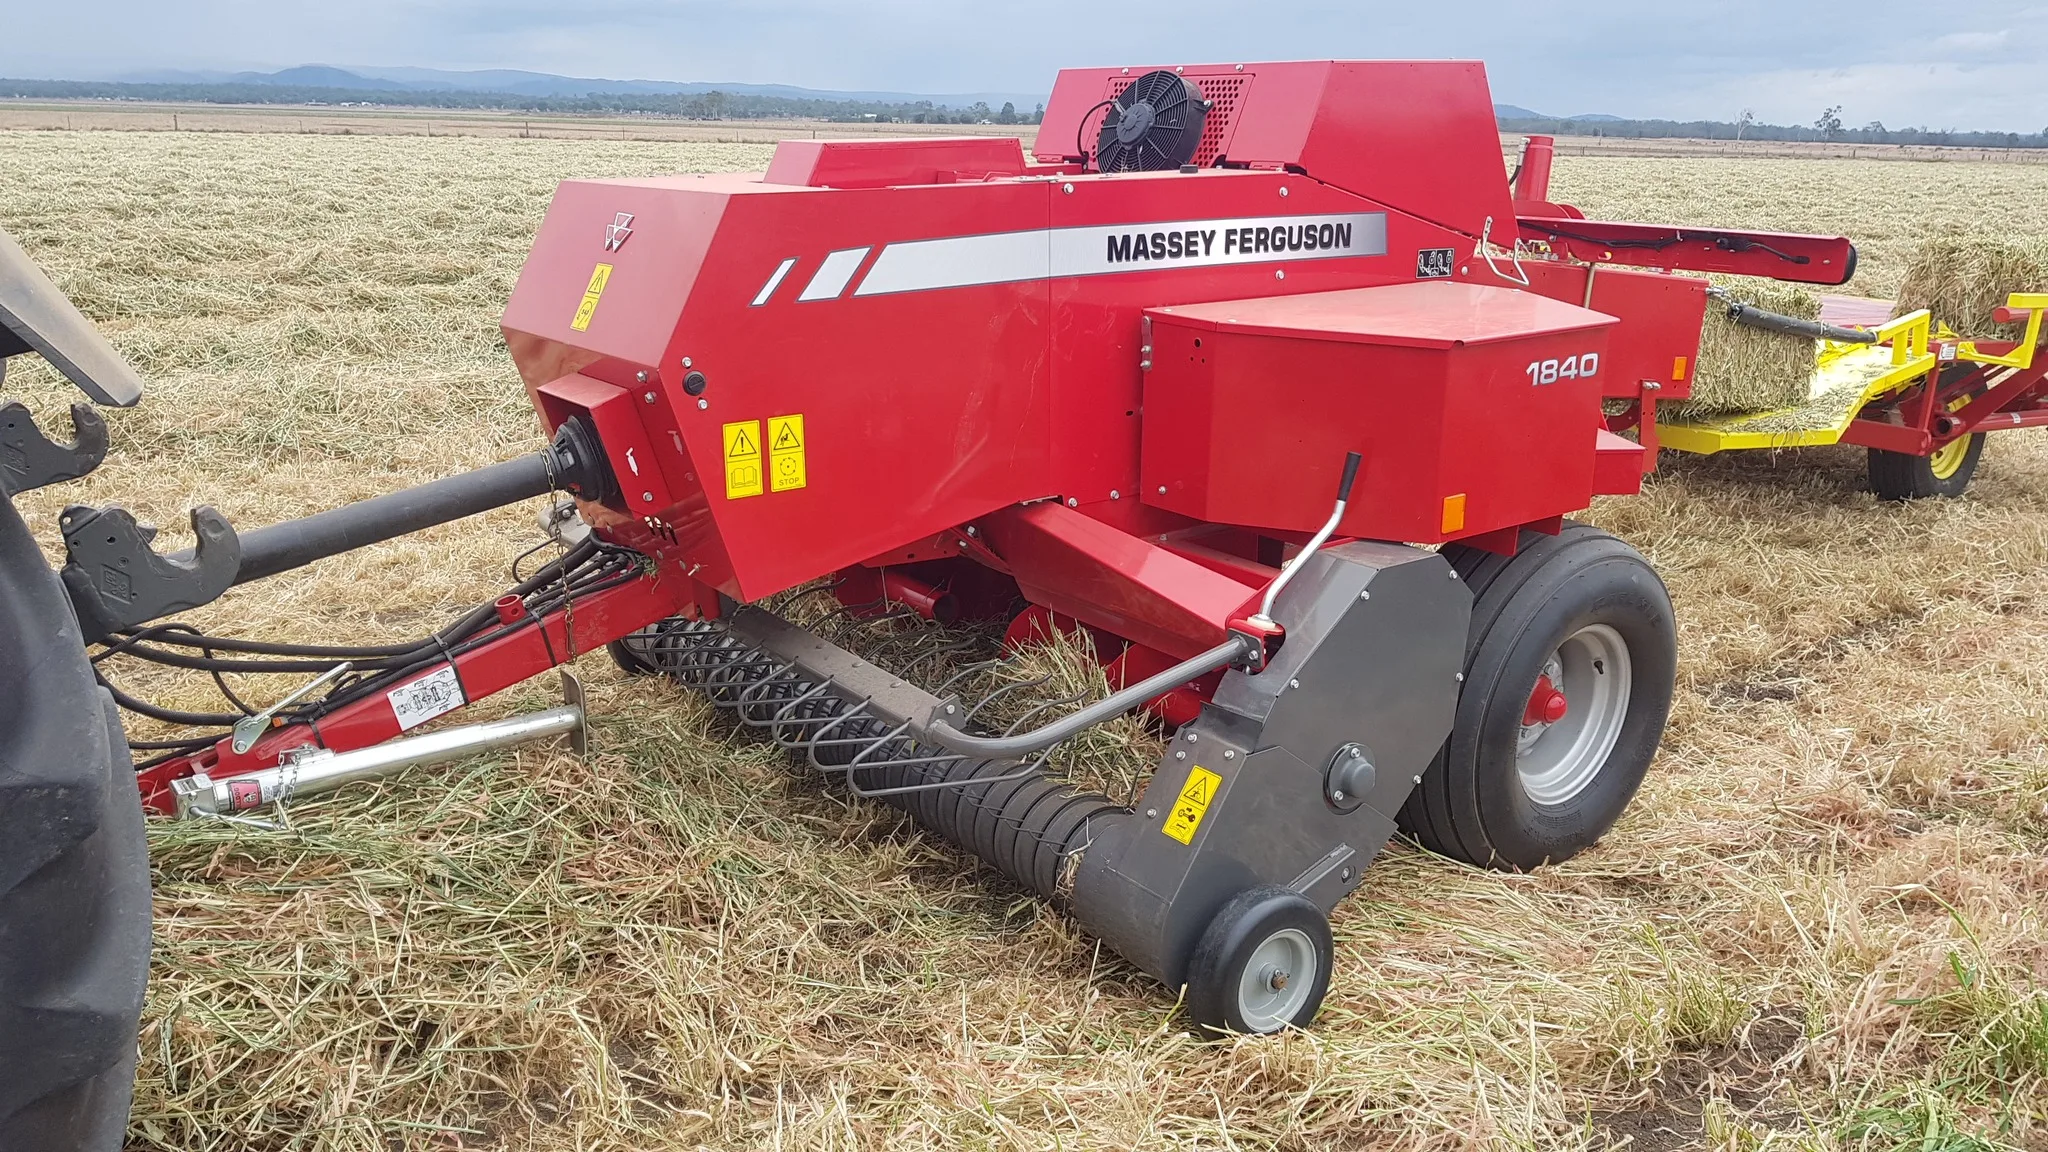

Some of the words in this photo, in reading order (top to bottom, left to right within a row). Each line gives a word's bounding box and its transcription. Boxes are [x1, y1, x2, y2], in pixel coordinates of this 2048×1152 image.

[1107, 229, 1216, 263] MASSEY
[1224, 222, 1352, 255] FERGUSON
[1526, 353, 1599, 386] 1840
[778, 477, 800, 486] STOP
